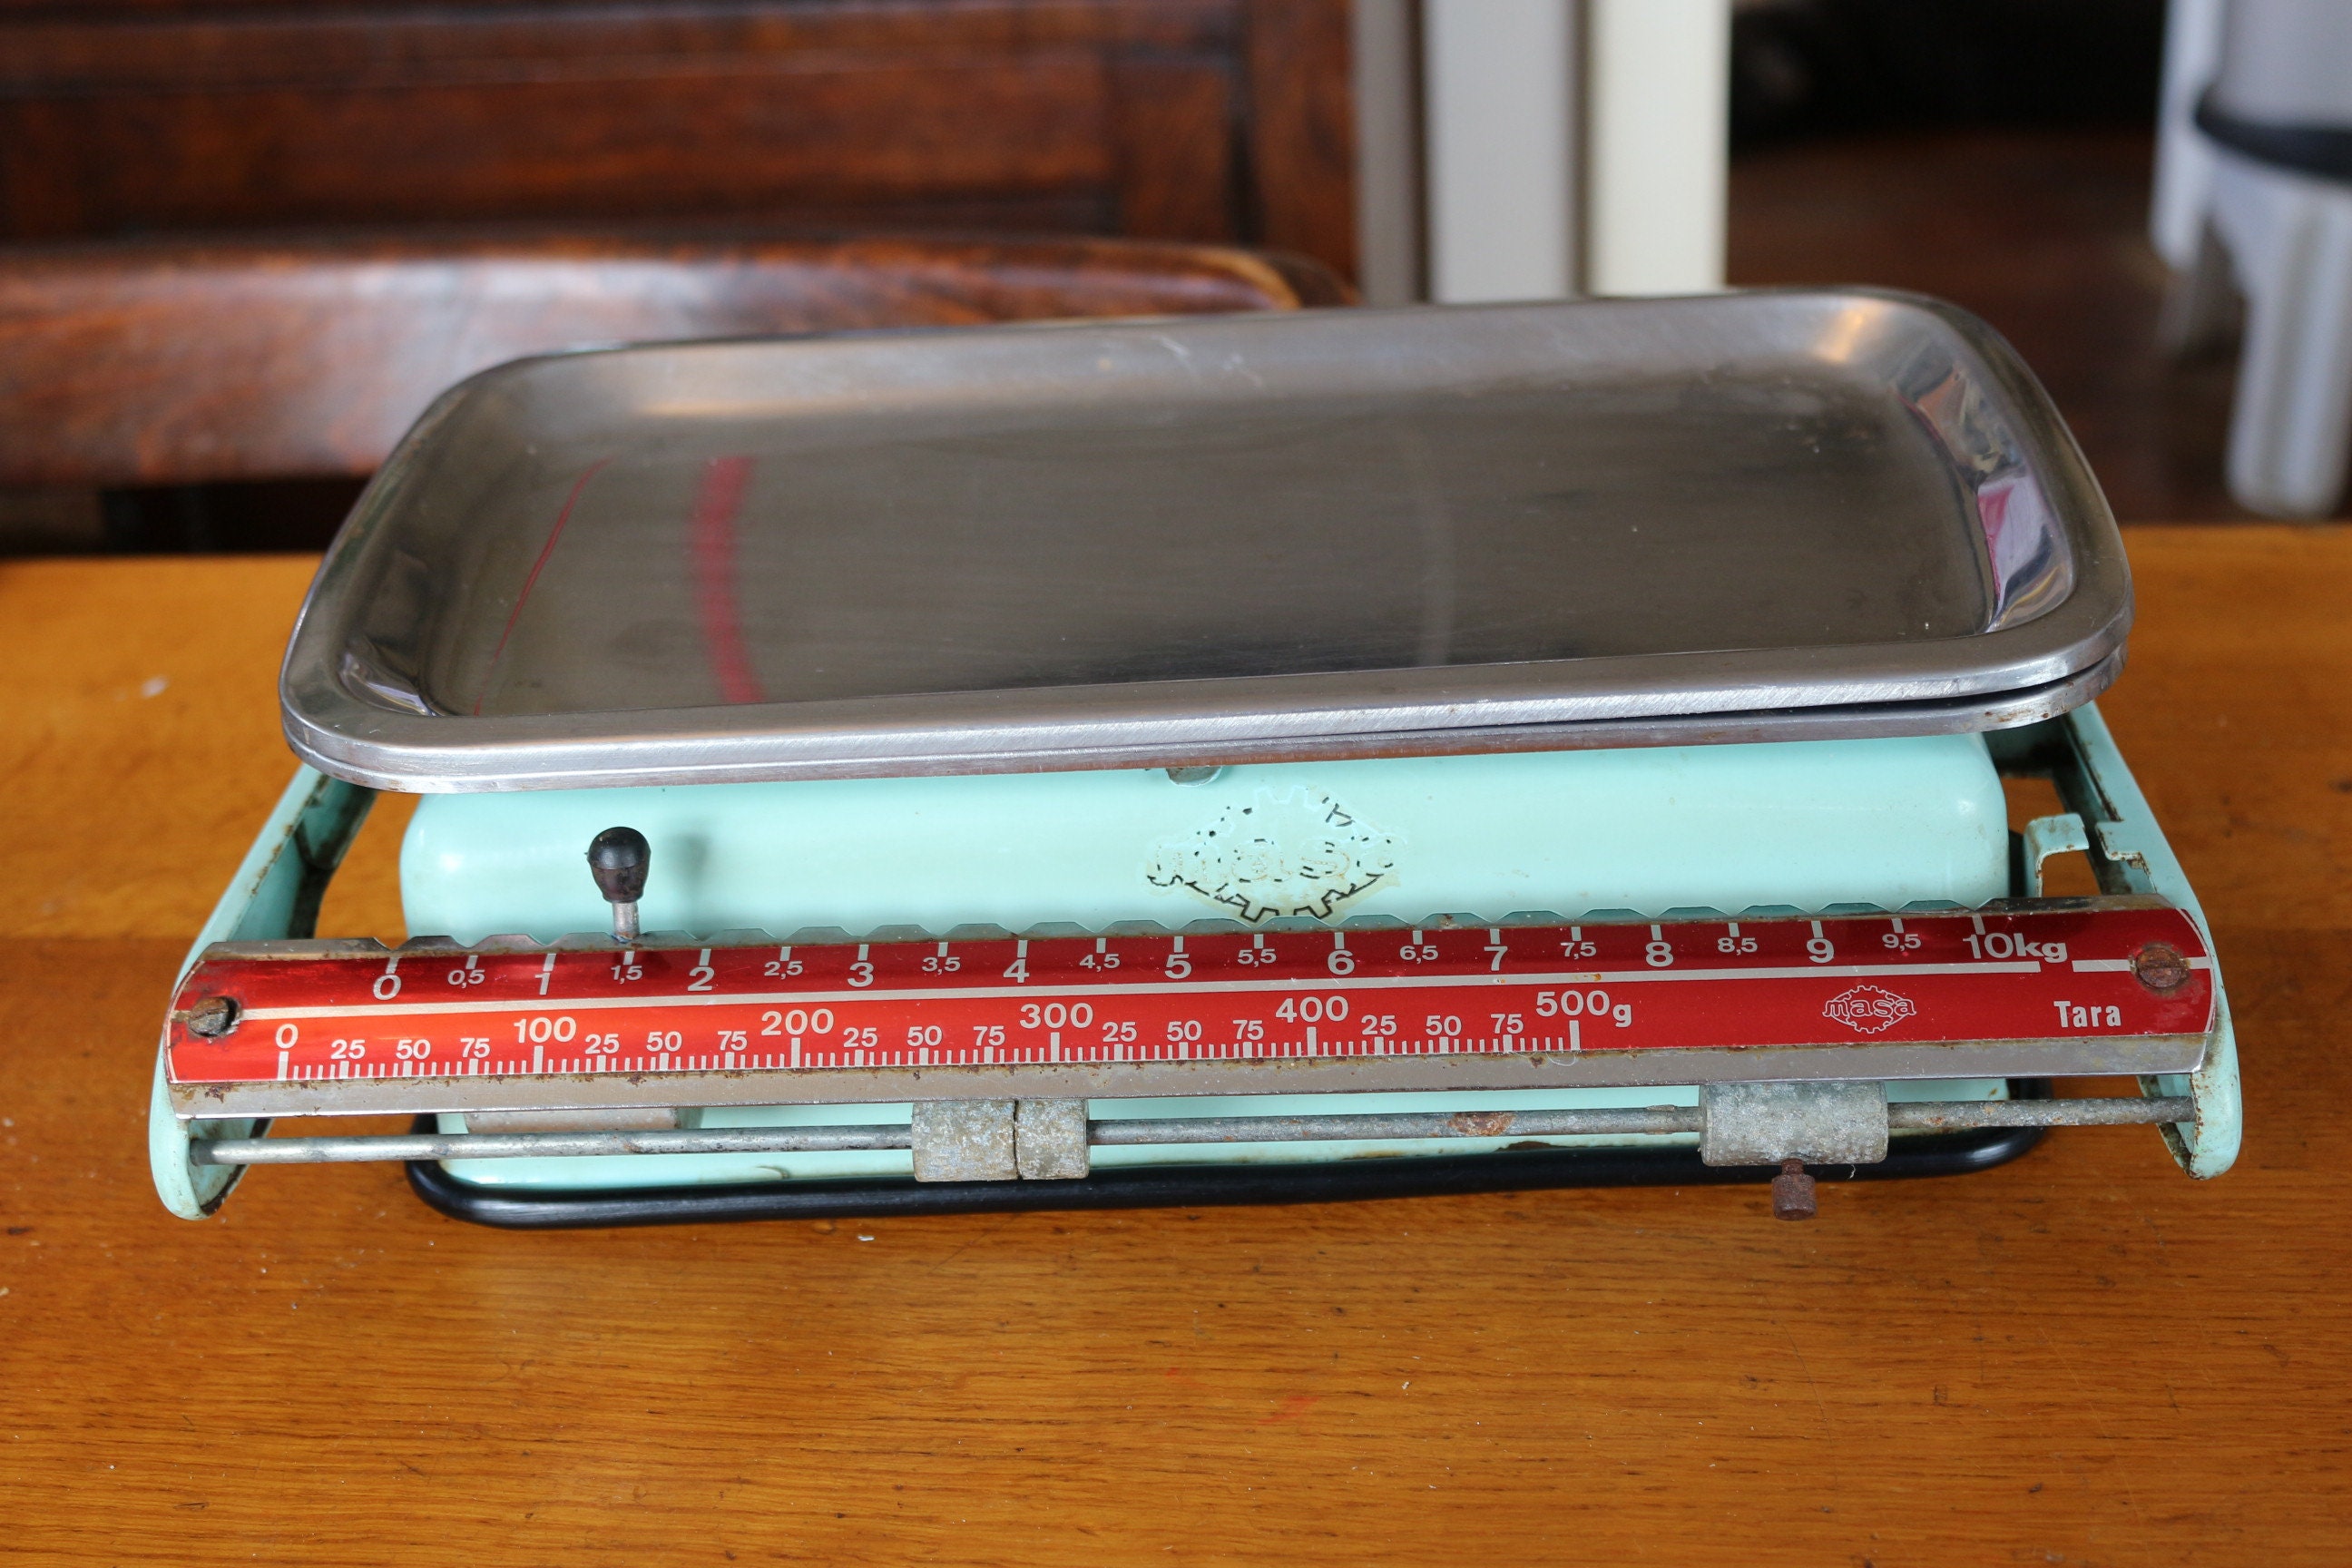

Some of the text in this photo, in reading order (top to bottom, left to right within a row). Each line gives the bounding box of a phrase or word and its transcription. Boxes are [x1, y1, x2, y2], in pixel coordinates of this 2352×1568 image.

[373, 933, 2068, 1000] 0 0,5 1 1,5 2 2,5 3 3,5 4 4,5 5 5,5 6 6,5 7 7,5 8 8,5 9 9,5 10kg
[275, 990, 1632, 1059] 0 25 50 75 100 25 50 75 200 25 50 75 300 25 50 75 400 25 50 75 500g
[1822, 999, 1916, 1017] masa
[2053, 1001, 2122, 1028] Tara
